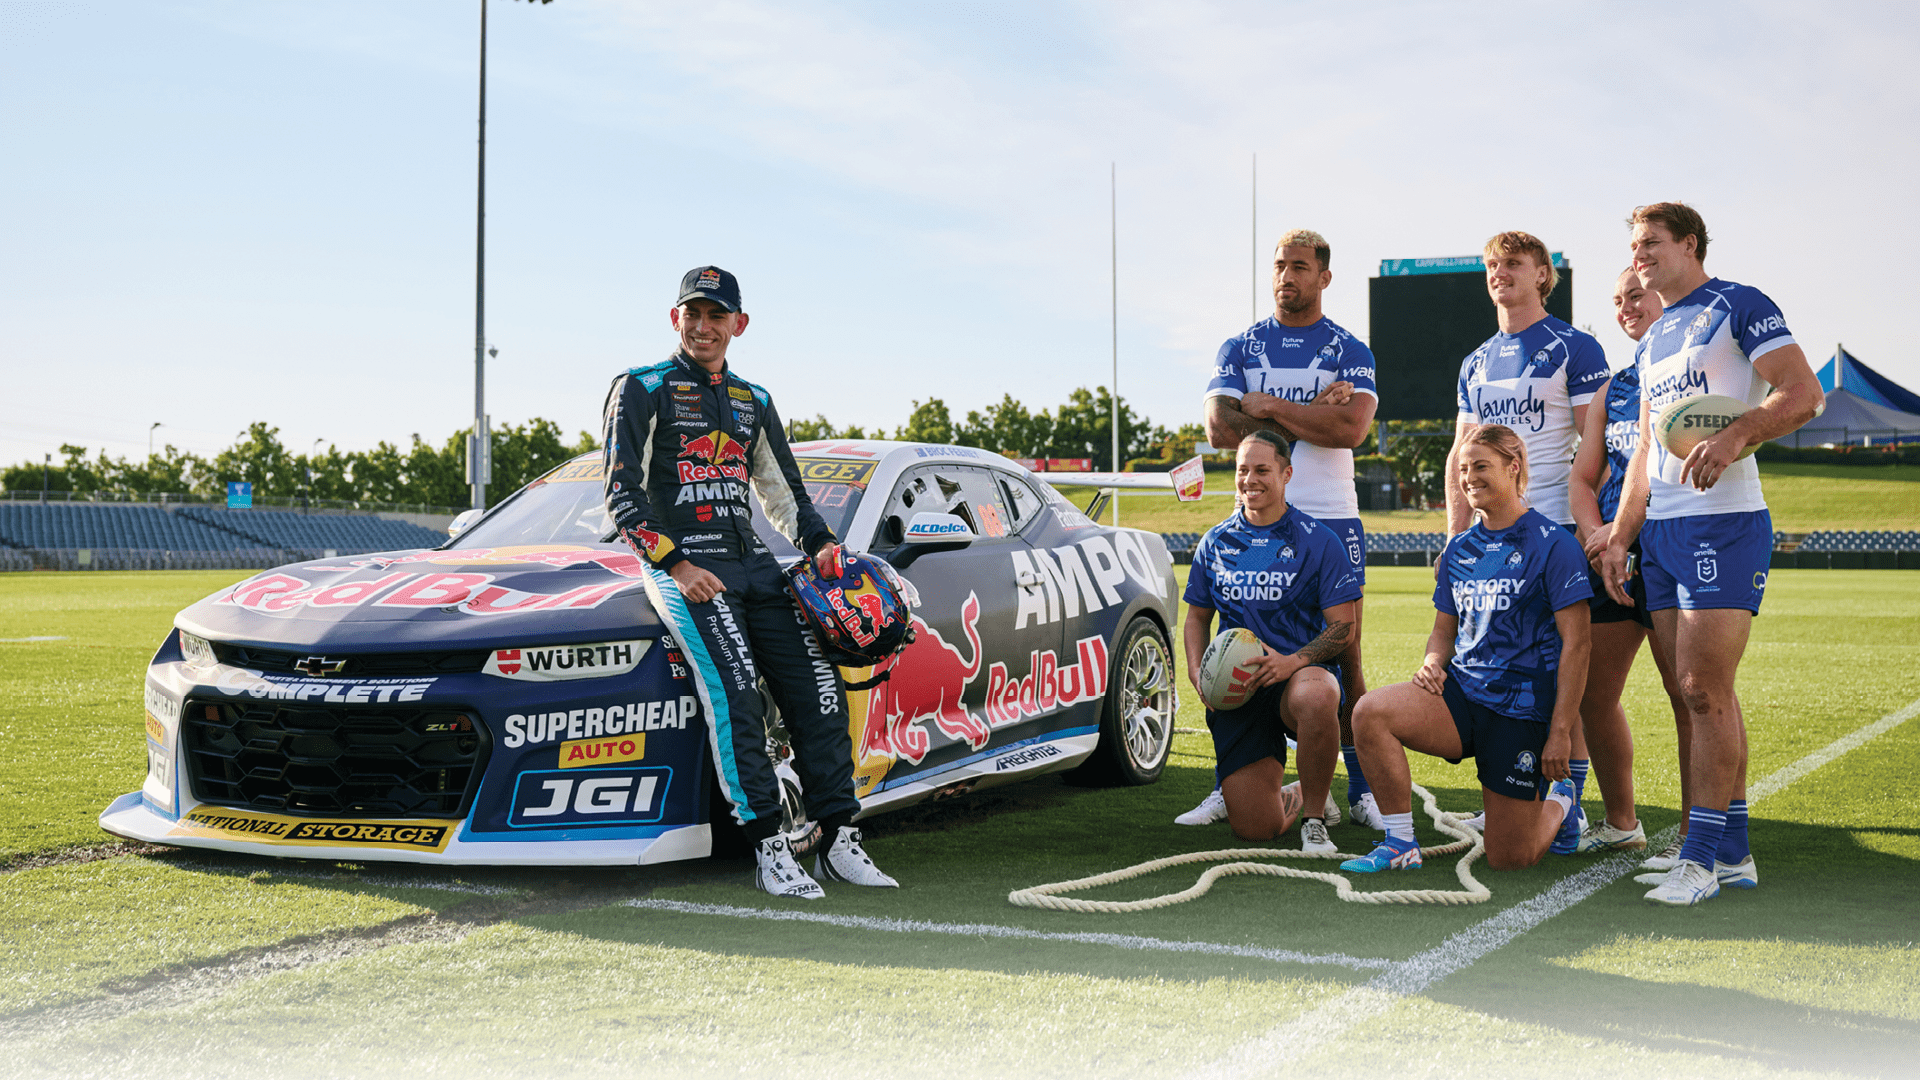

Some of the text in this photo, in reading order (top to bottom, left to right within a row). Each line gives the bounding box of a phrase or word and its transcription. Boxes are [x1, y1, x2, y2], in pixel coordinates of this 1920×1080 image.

[1260, 371, 1325, 403] laund
[674, 403, 690, 411] Shaw
[675, 410, 702, 418] Partners
[1476, 384, 1545, 432] laundy
[1683, 414, 1740, 428] STEED
[547, 464, 603, 480] NATI
[678, 460, 748, 484] Red Bull
[681, 533, 722, 544] ACDelco
[909, 523, 967, 535] ACDelco
[1011, 531, 1168, 630] AMPOL
[1215, 570, 1298, 587] FACTORY
[1452, 578, 1527, 596] FACTORY
[213, 571, 643, 616] Red Bull
[1222, 586, 1283, 601] SOUND
[1457, 594, 1511, 613] SOUND
[826, 587, 876, 648] Red Bull
[661, 635, 680, 649] Sh
[706, 615, 746, 691] Premium Fuels
[712, 592, 760, 694] AMPLIFY
[527, 644, 632, 671] WÜRTH
[667, 652, 685, 663] an
[216, 668, 431, 703] COMPLETE
[811, 658, 839, 715] WINGS
[986, 651, 1040, 727] Red
[1039, 635, 1108, 711] Bull
[425, 723, 458, 731] ZL1
[504, 695, 698, 748] SUPERCHEAP
[567, 740, 636, 762] AUTO
[997, 743, 1062, 771] FREIGHTER
[522, 776, 659, 817] JGI
[182, 813, 438, 843] NATIONAL STORAGE
[787, 884, 820, 896] OMP
